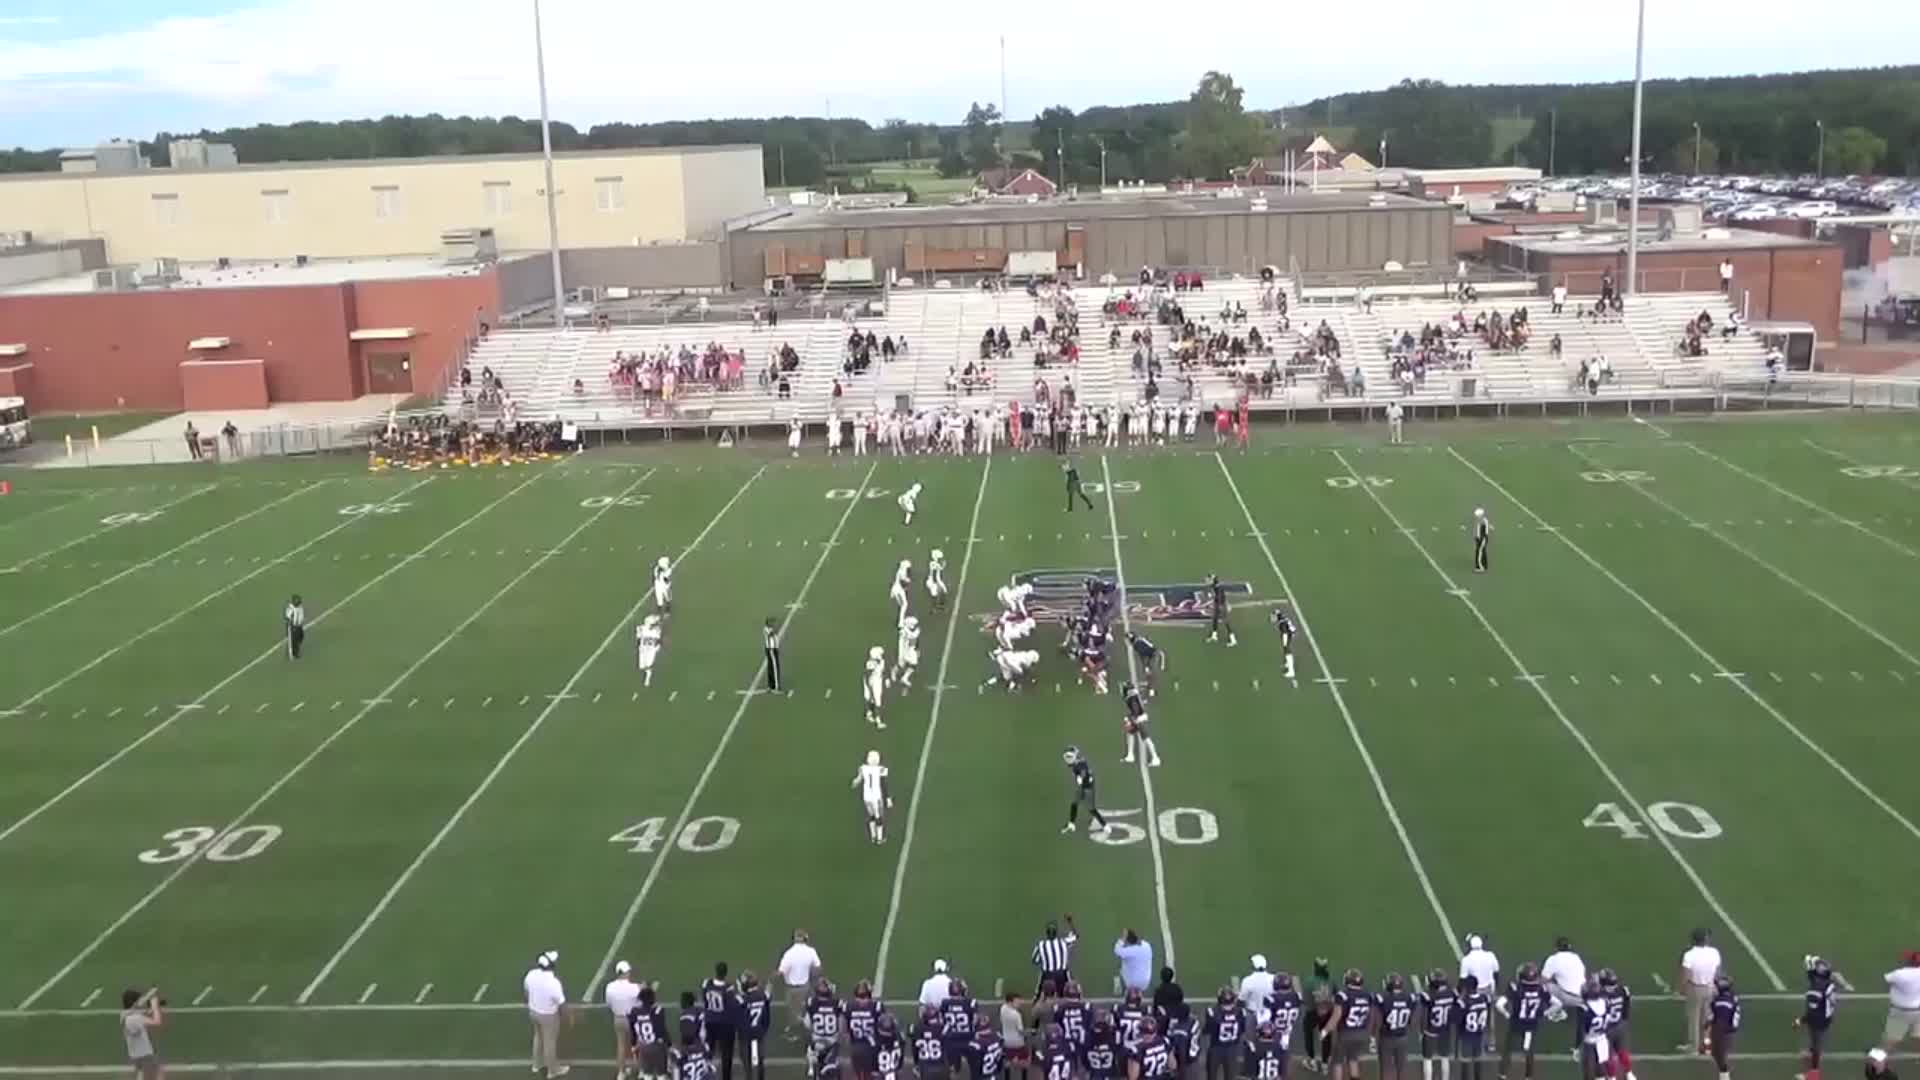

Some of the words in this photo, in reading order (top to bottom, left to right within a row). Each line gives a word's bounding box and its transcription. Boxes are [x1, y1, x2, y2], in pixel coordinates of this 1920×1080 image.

[1088, 807, 1219, 844] 50
[1582, 801, 1722, 839] 40
[138, 825, 282, 863] 30
[608, 816, 741, 852] 40
[749, 1008, 762, 1027] 7
[1386, 1008, 1411, 1031] 40
[1518, 998, 1542, 1019] 17
[633, 1021, 656, 1043] 18
[812, 1013, 837, 1035] 28
[1062, 1016, 1085, 1044] 15
[915, 1039, 942, 1061] 36
[1257, 1058, 1280, 1080] 16
